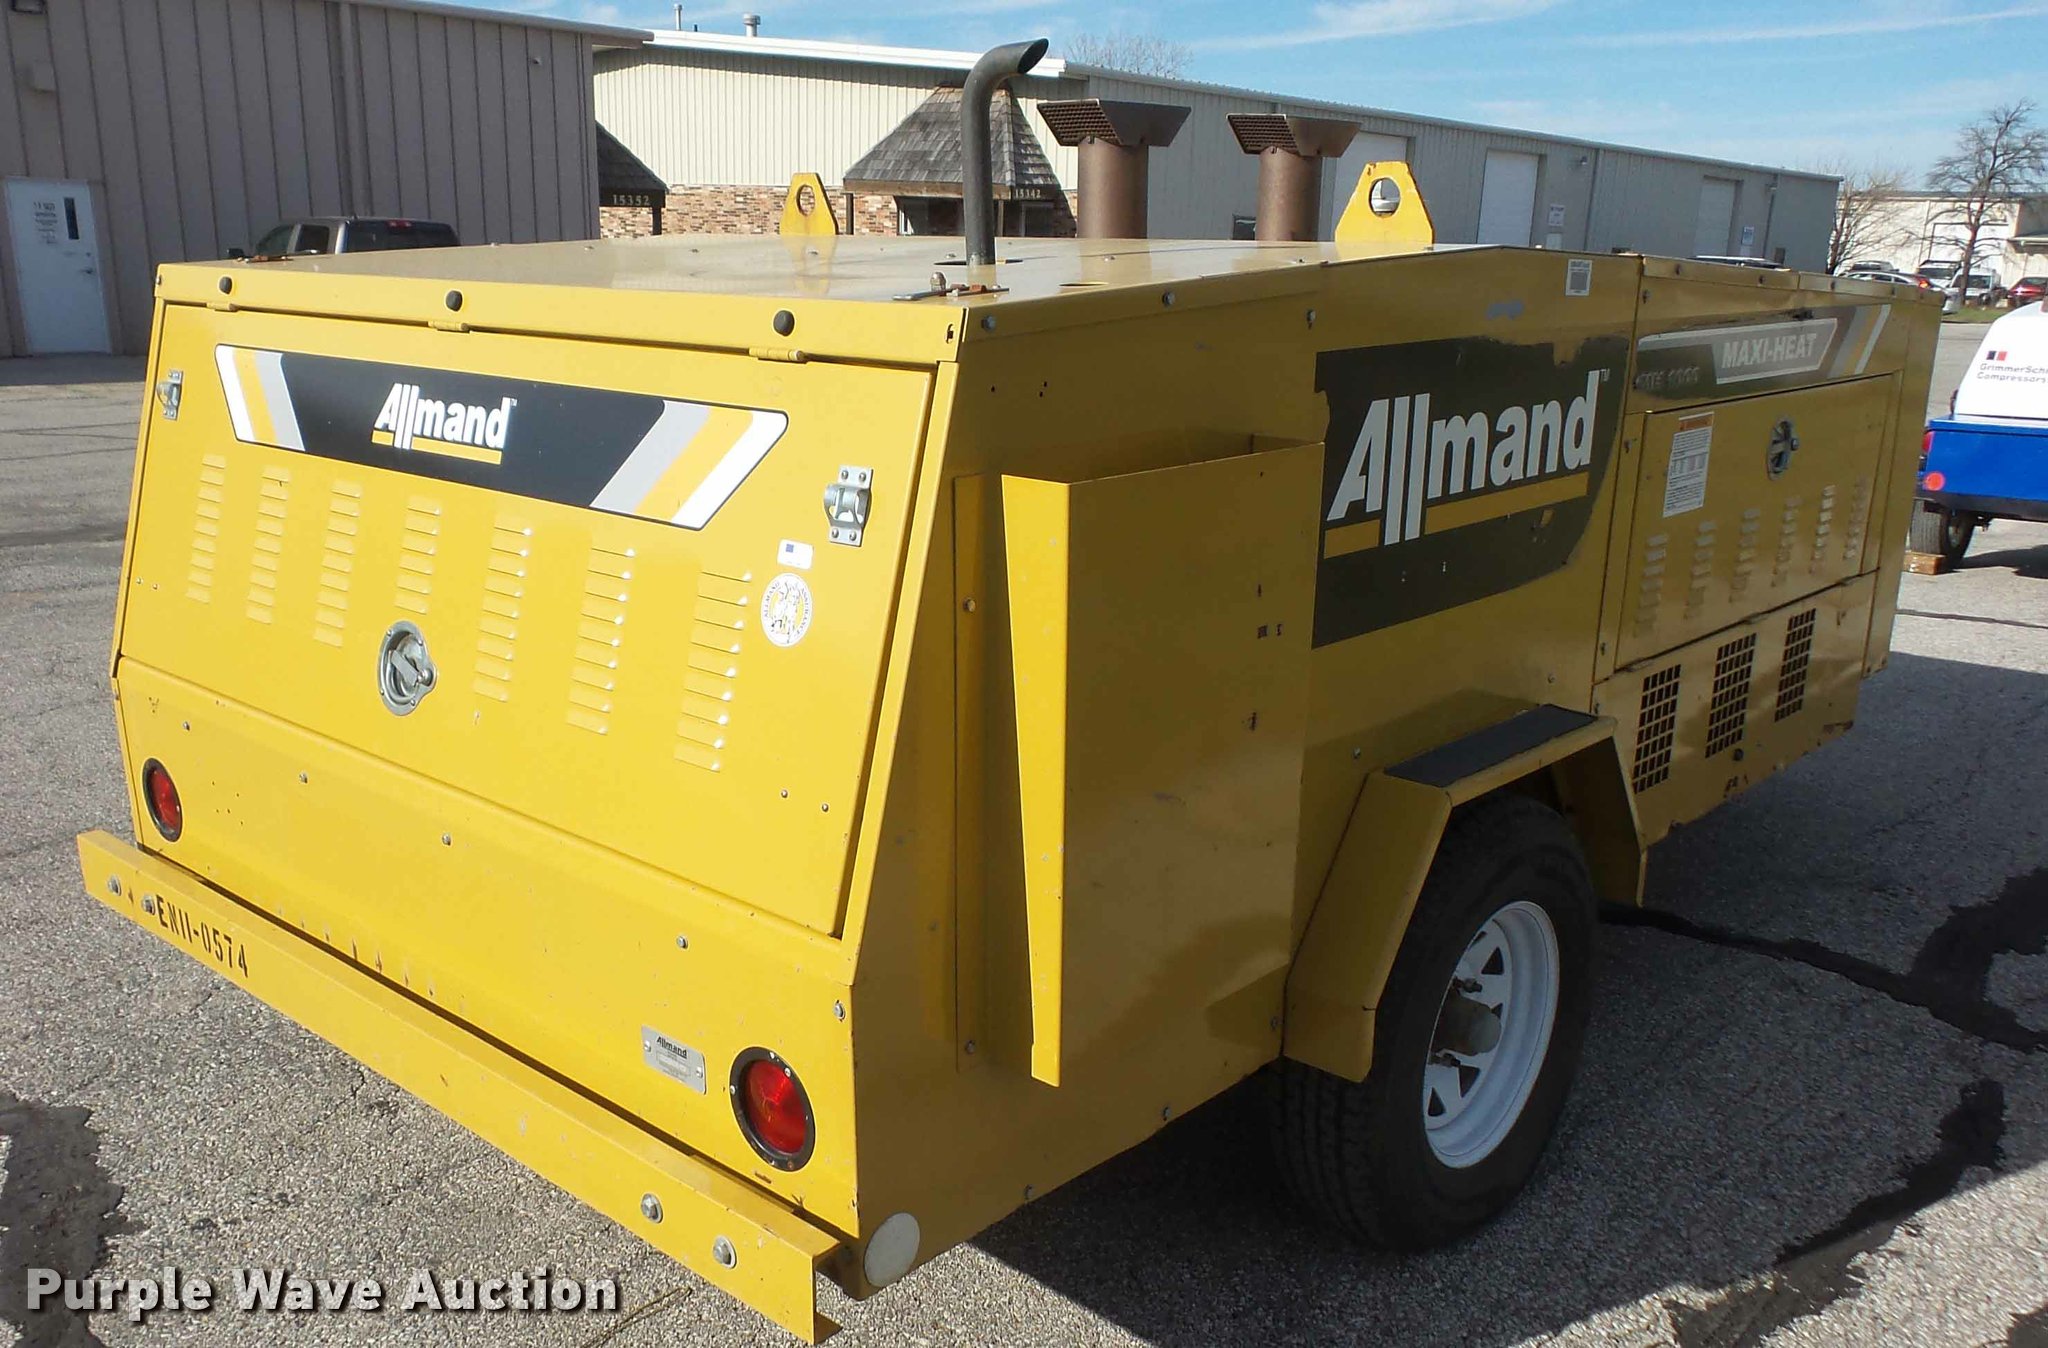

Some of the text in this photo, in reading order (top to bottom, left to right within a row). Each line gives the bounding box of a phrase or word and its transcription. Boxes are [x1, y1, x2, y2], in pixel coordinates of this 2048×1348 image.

[613, 194, 650, 205] 15352
[1721, 333, 1817, 368] MAXI-HEAT
[1977, 371, 2047, 383] Compressors
[1980, 363, 2048, 374] GrimmerSch
[374, 383, 511, 450] Allmand
[1326, 369, 1600, 546] Allmand
[656, 1036, 688, 1057] Allmand
